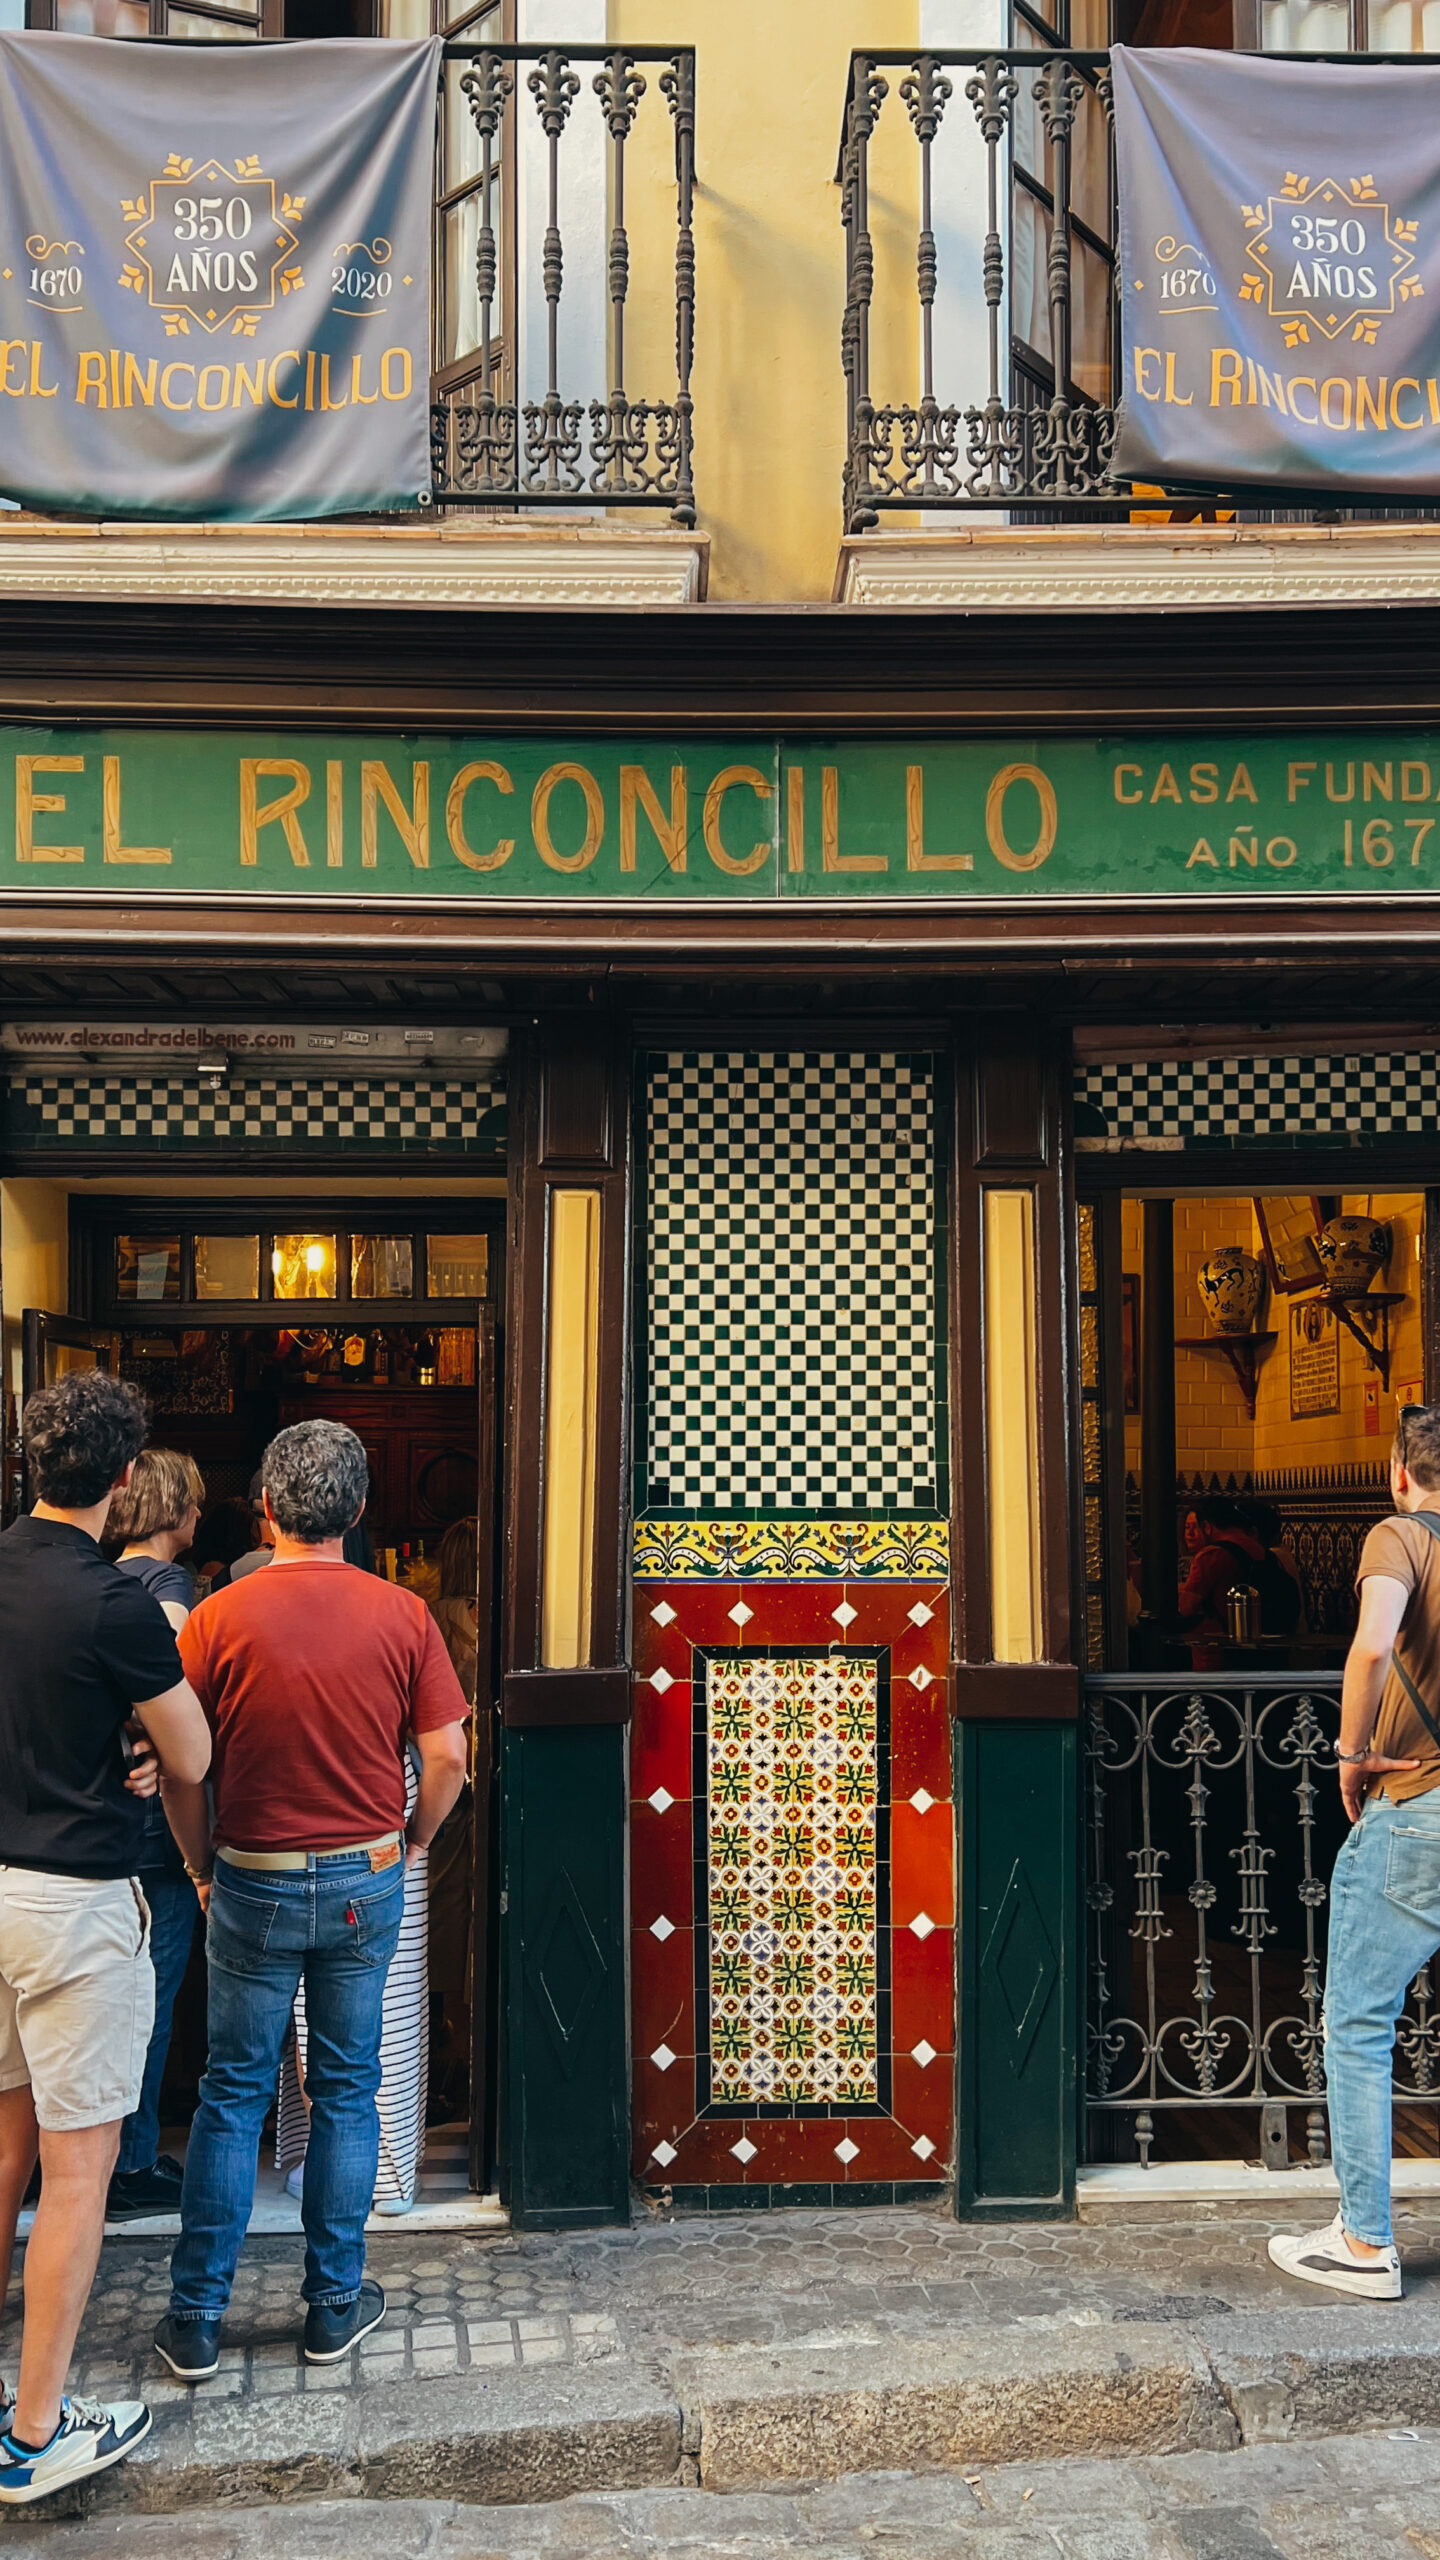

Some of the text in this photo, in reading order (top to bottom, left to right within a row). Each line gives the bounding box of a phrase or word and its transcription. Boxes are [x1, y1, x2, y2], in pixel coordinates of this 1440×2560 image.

[173, 197, 252, 241] 350
[1290, 215, 1366, 256] 350
[28, 264, 83, 297] 1670
[165, 246, 258, 294] AÑOS
[331, 265, 393, 300] 2020
[1160, 266, 1217, 299] 1670
[1286, 256, 1378, 300] AÑOS
[0, 339, 413, 411] EL RINCONCILLO
[1133, 346, 1440, 432] EL RINCONCI
[1113, 761, 1440, 804] CASA FUND
[15, 755, 1058, 876] EL RINCONCILLO
[1185, 818, 1436, 869] AÑO 167
[15, 1027, 296, 1049] www.alexandradelbene.com
